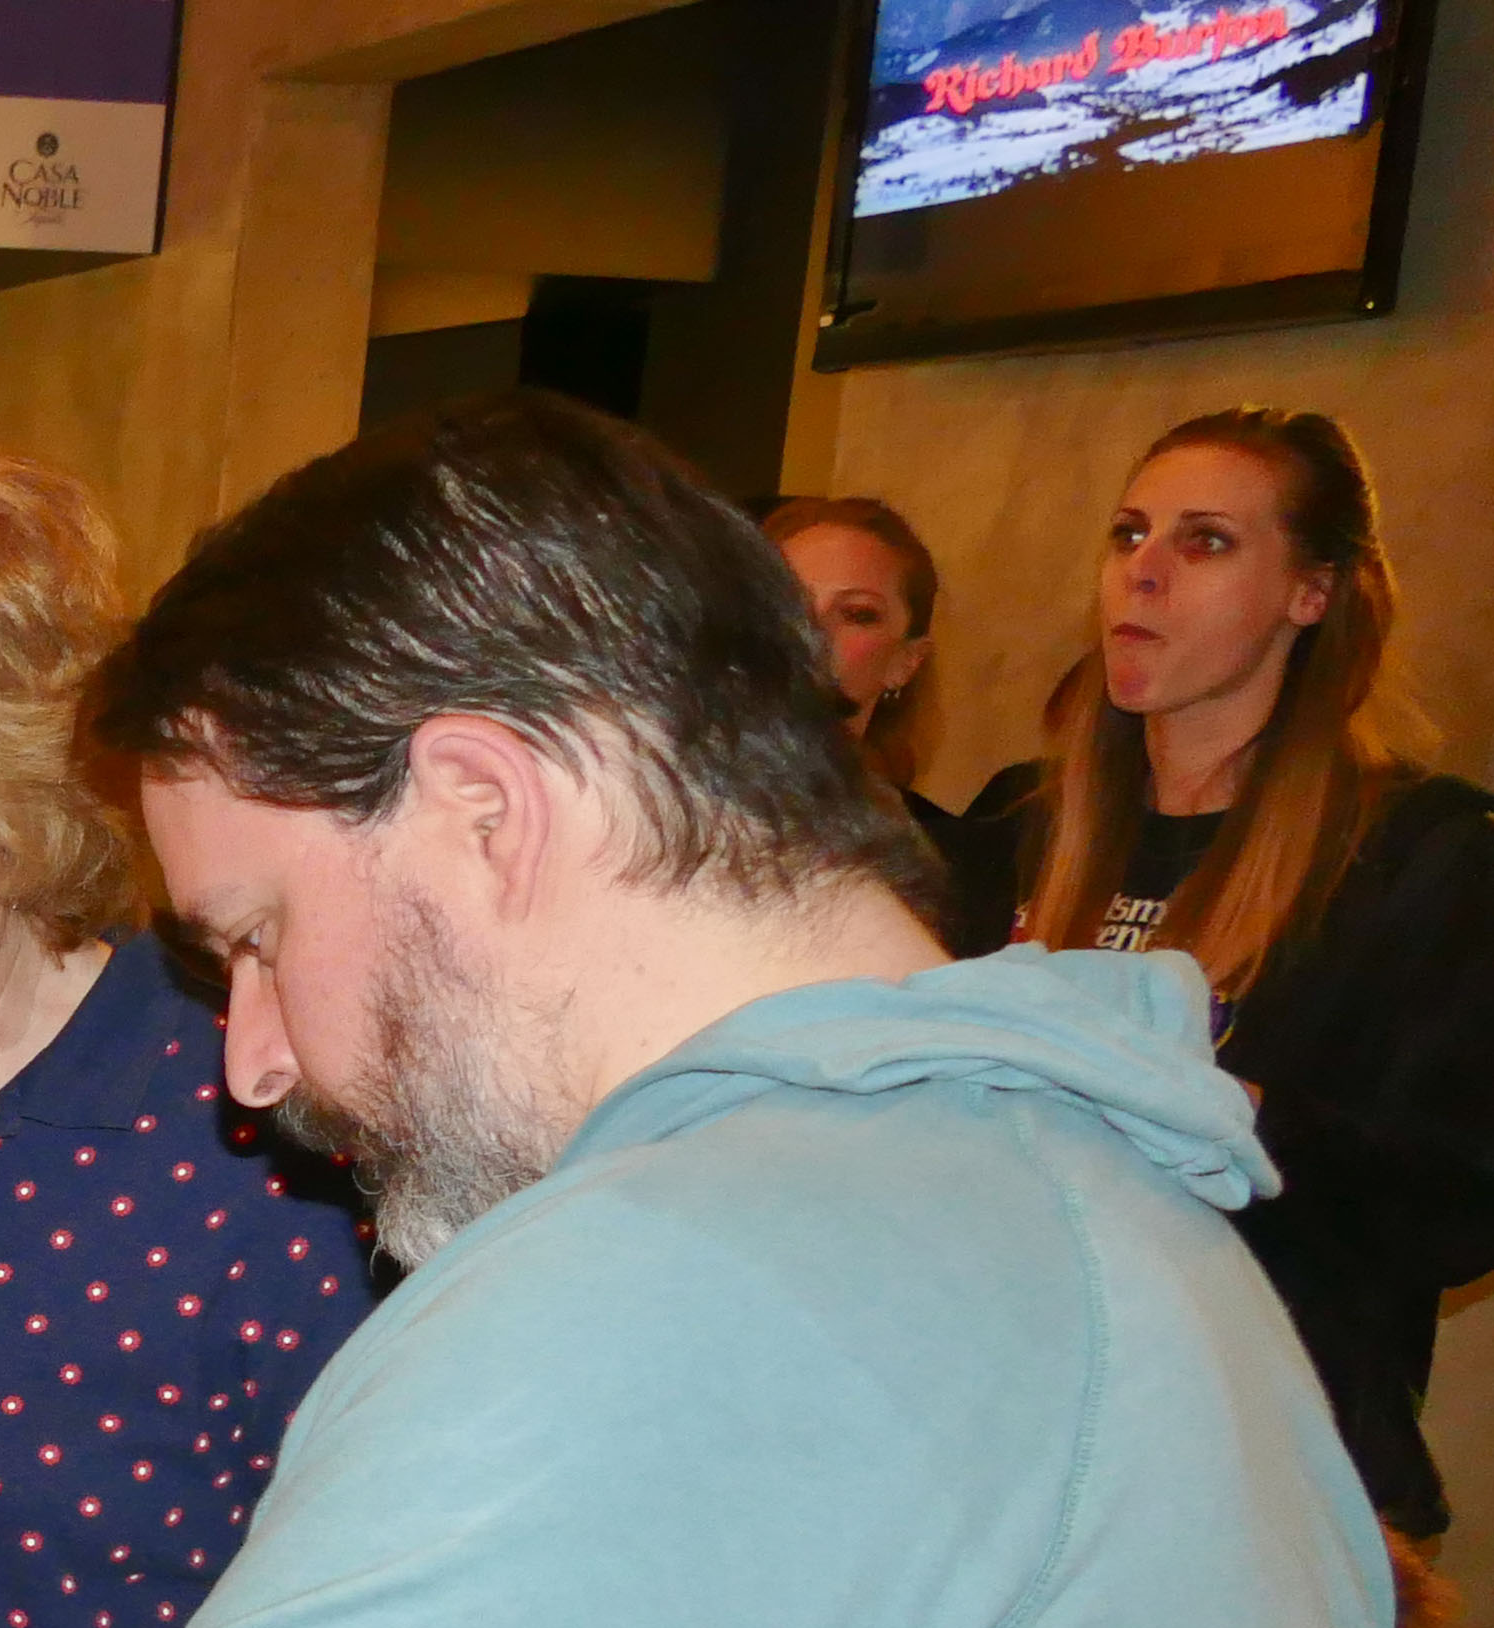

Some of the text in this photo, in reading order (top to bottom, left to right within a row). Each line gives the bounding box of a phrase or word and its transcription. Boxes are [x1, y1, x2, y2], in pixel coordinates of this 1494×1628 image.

[922, 7, 1289, 115] Richard Burton
[9, 159, 79, 185] CASA
[1, 182, 85, 209] NOBLE
